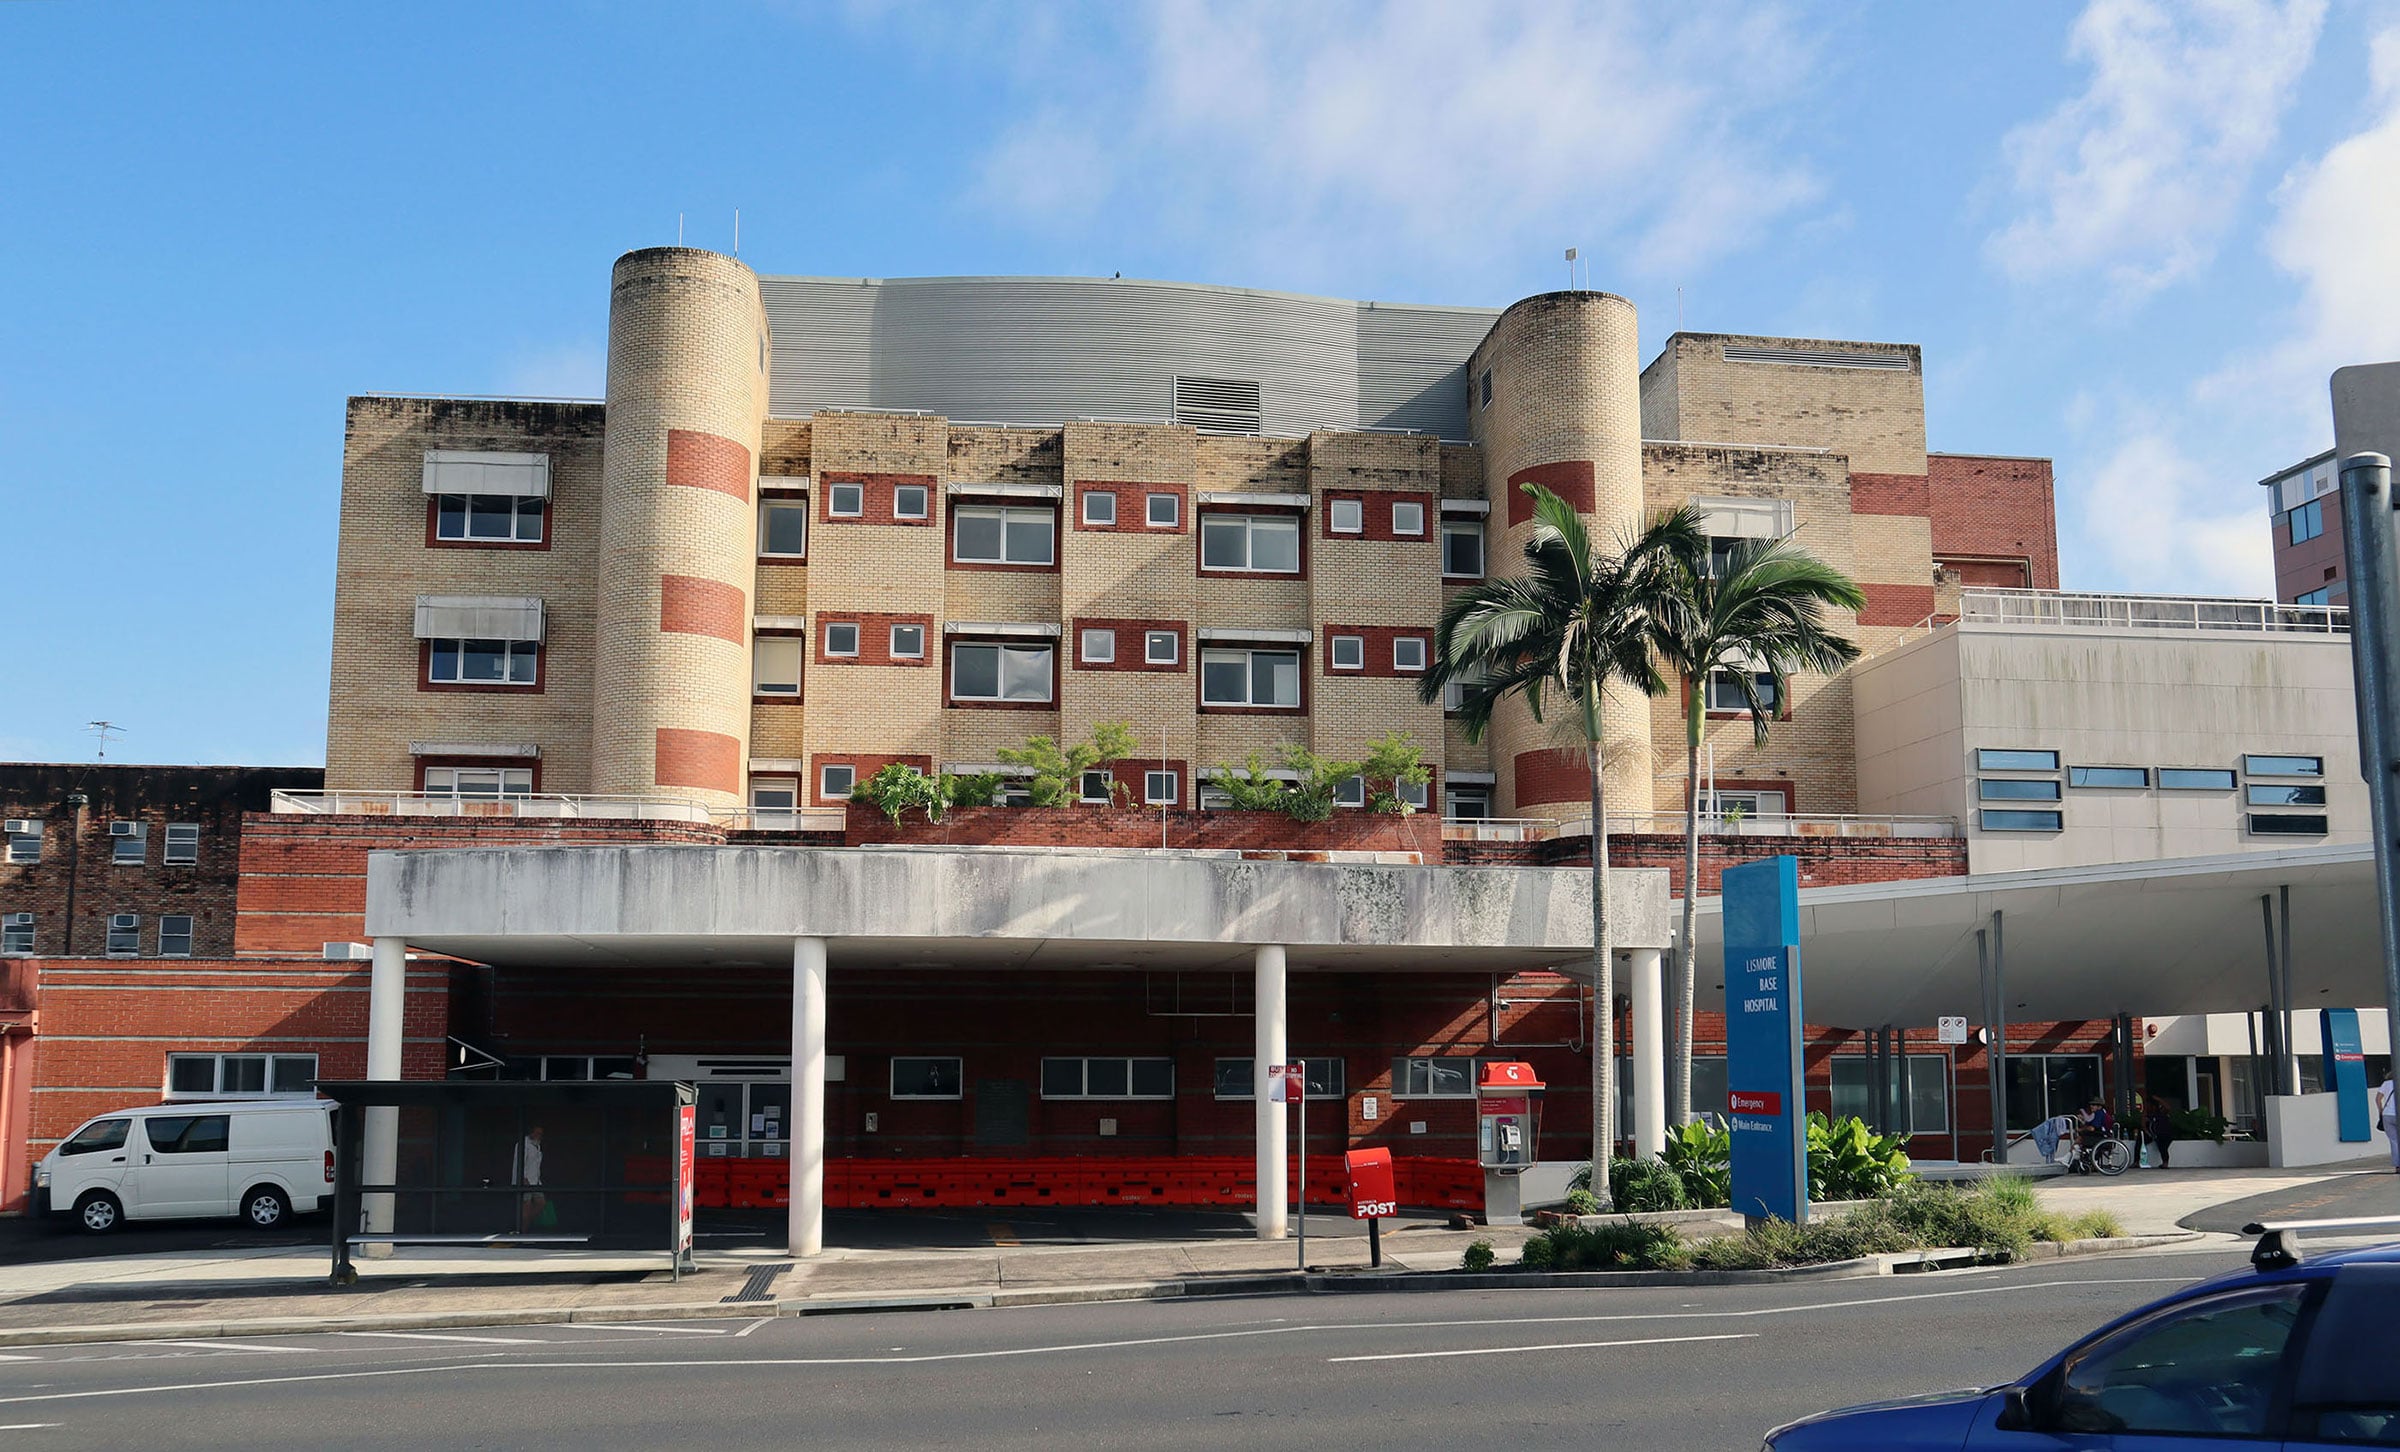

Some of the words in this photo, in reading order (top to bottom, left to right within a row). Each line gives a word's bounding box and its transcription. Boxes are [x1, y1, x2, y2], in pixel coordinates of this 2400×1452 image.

[1746, 956, 1777, 973] LISMORE
[1759, 976, 1777, 991] BASE
[1744, 998, 1778, 1013] HOSPITAL
[1738, 1098, 1764, 1110] Emergency
[1738, 1120, 1750, 1130] Main
[1751, 1120, 1772, 1132] Entrance
[1357, 1201, 1396, 1217] POST
